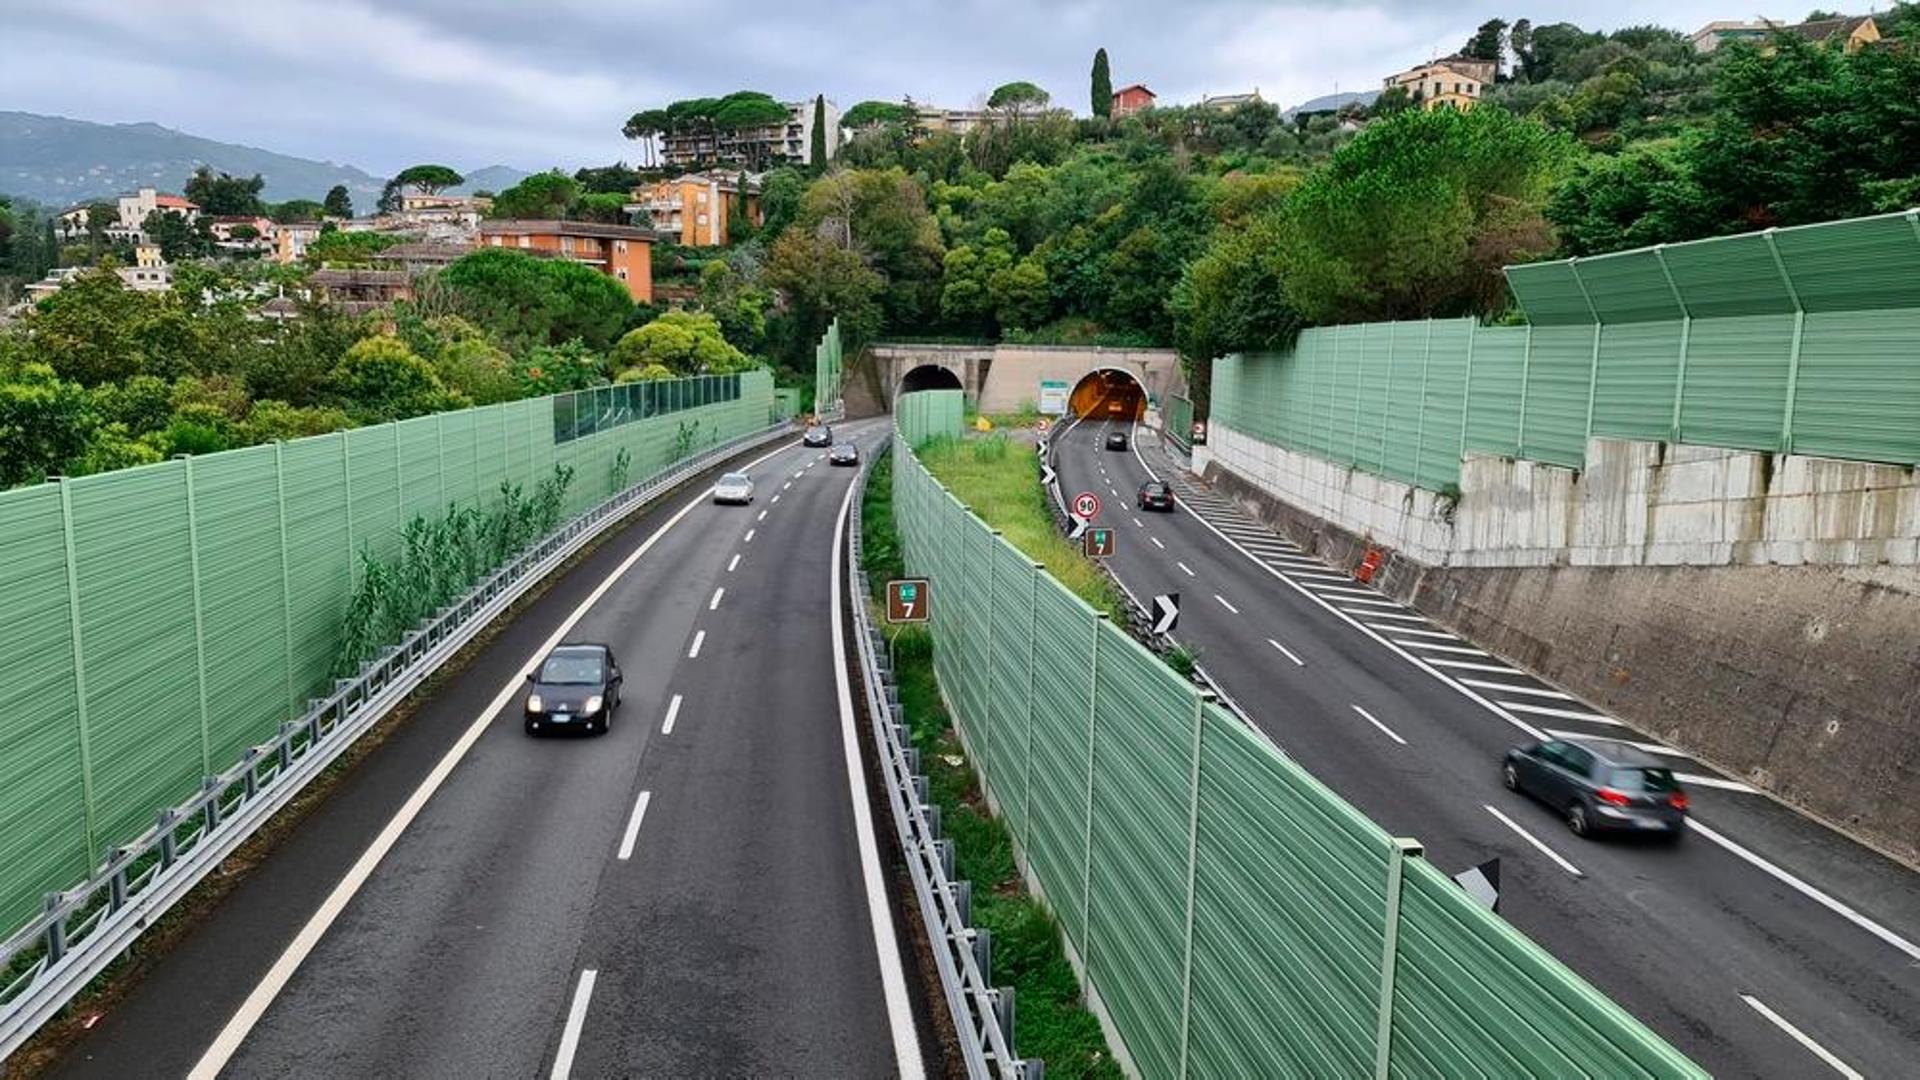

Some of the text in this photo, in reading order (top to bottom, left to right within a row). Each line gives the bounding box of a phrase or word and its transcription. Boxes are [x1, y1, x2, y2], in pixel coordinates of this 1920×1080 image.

[1080, 500, 1094, 511] 90
[1096, 543, 1104, 554] 7
[902, 603, 914, 618] 7
